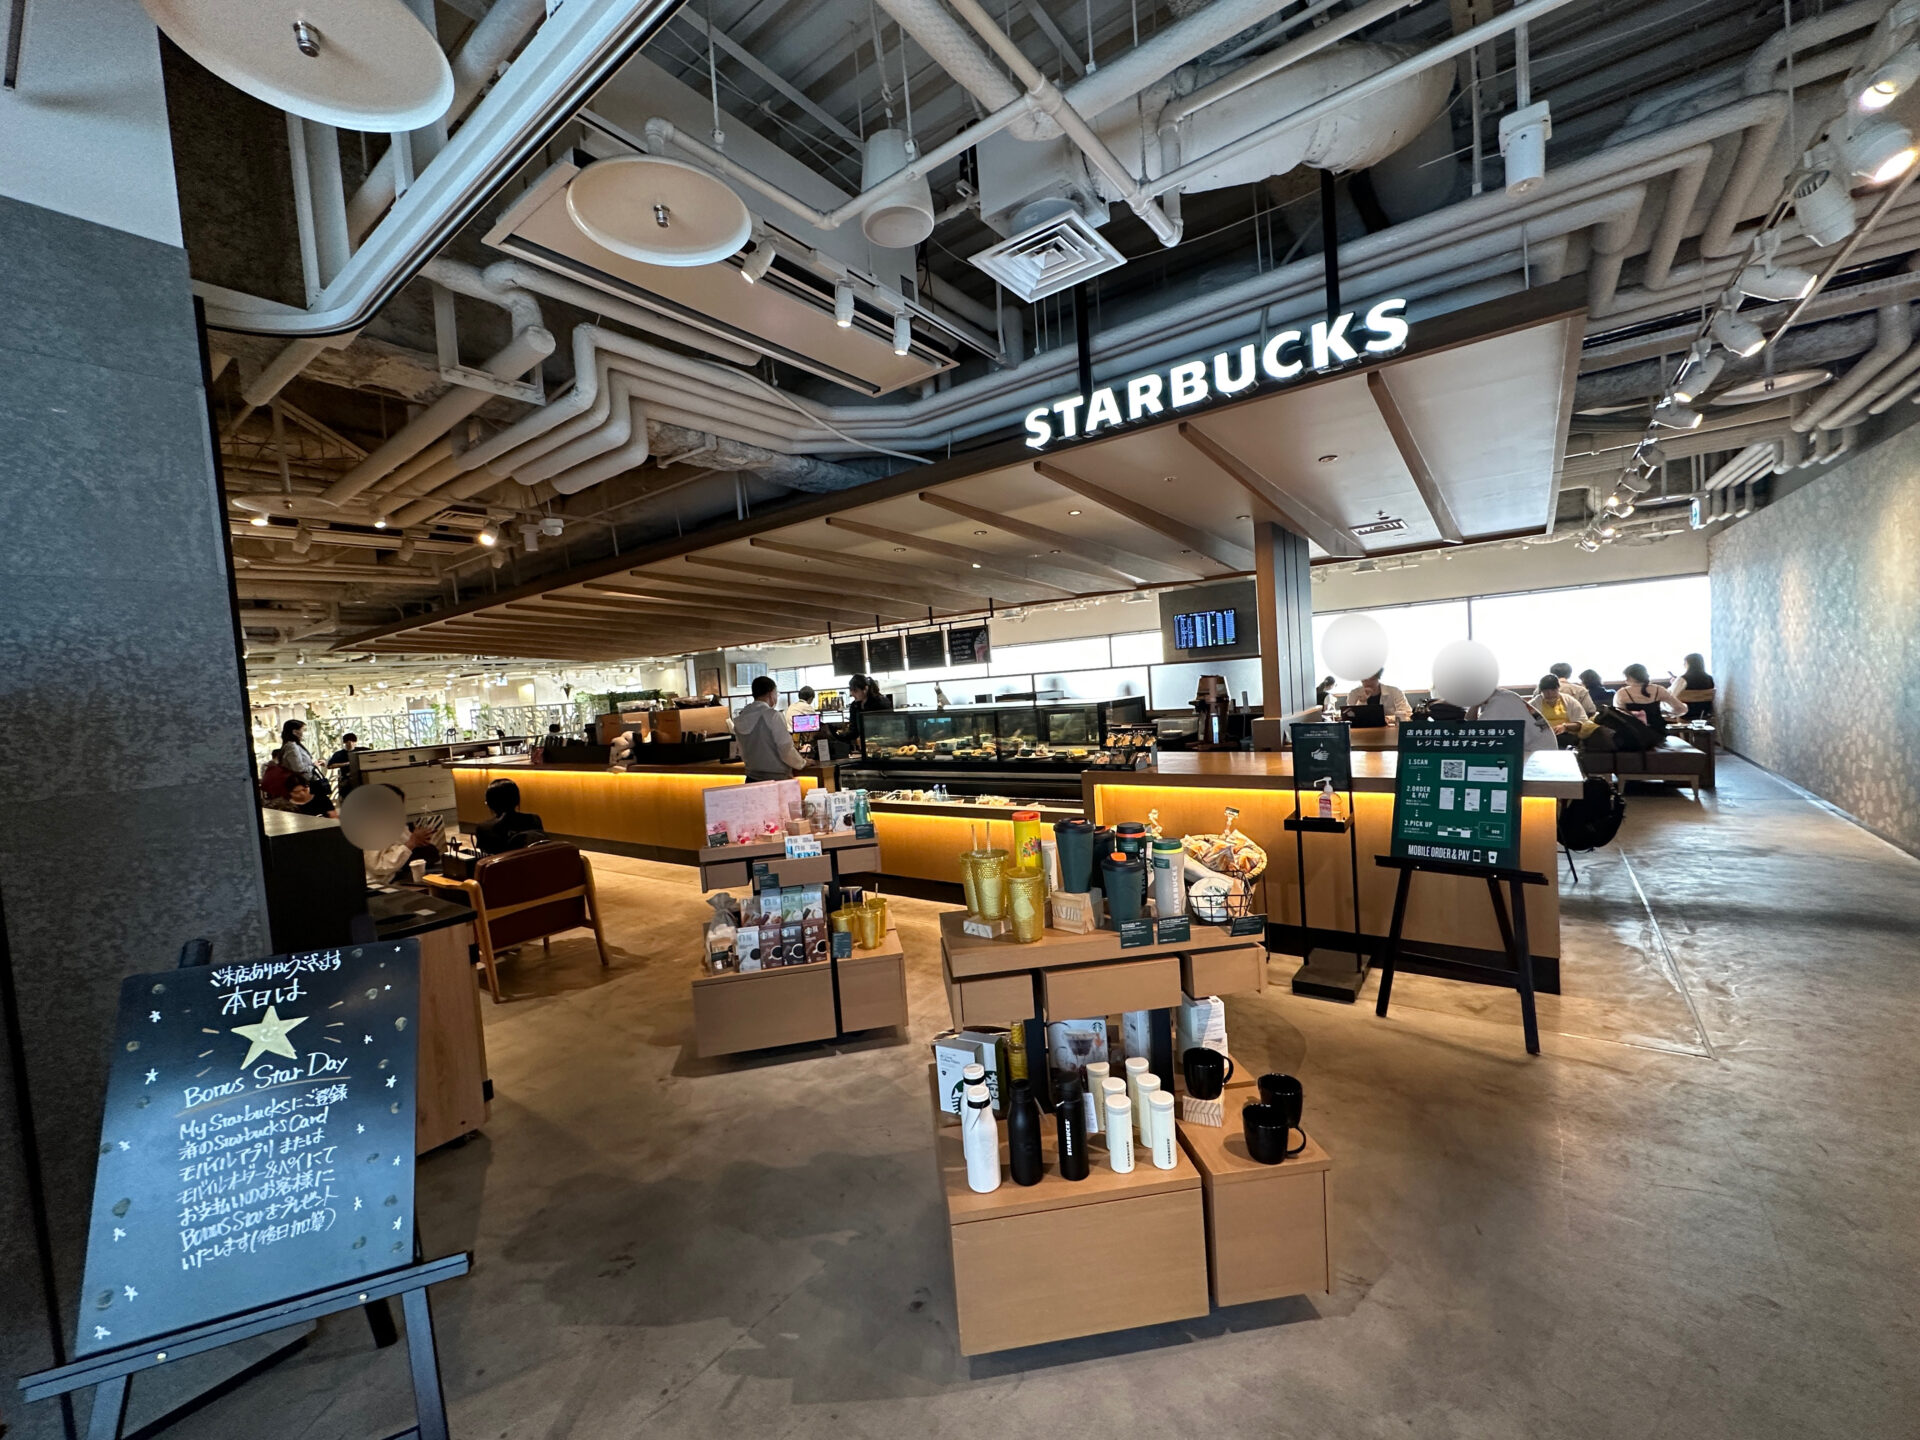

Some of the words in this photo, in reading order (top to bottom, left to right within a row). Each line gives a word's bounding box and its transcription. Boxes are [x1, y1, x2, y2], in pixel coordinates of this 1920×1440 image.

[1025, 298, 1409, 449] STARBUCKS
[1406, 728, 1515, 736] 店内利用も、お持ち帰りも
[1416, 739, 1503, 747] レジに並ばずオーダー
[1408, 844, 1430, 857] MOBILE
[1431, 846, 1451, 859] ORDER
[1451, 849, 1457, 860] &
[1458, 850, 1471, 861] PAY
[1172, 865, 1180, 914] STARBUCKS
[218, 978, 307, 1015] 本日は
[184, 1076, 245, 1109] Bonus
[253, 1064, 304, 1089] Star
[307, 1052, 348, 1077] Day
[179, 1120, 207, 1141] My
[1064, 1119, 1073, 1156] STARBUCKS
[177, 1169, 336, 1226] お支払いのお客様に
